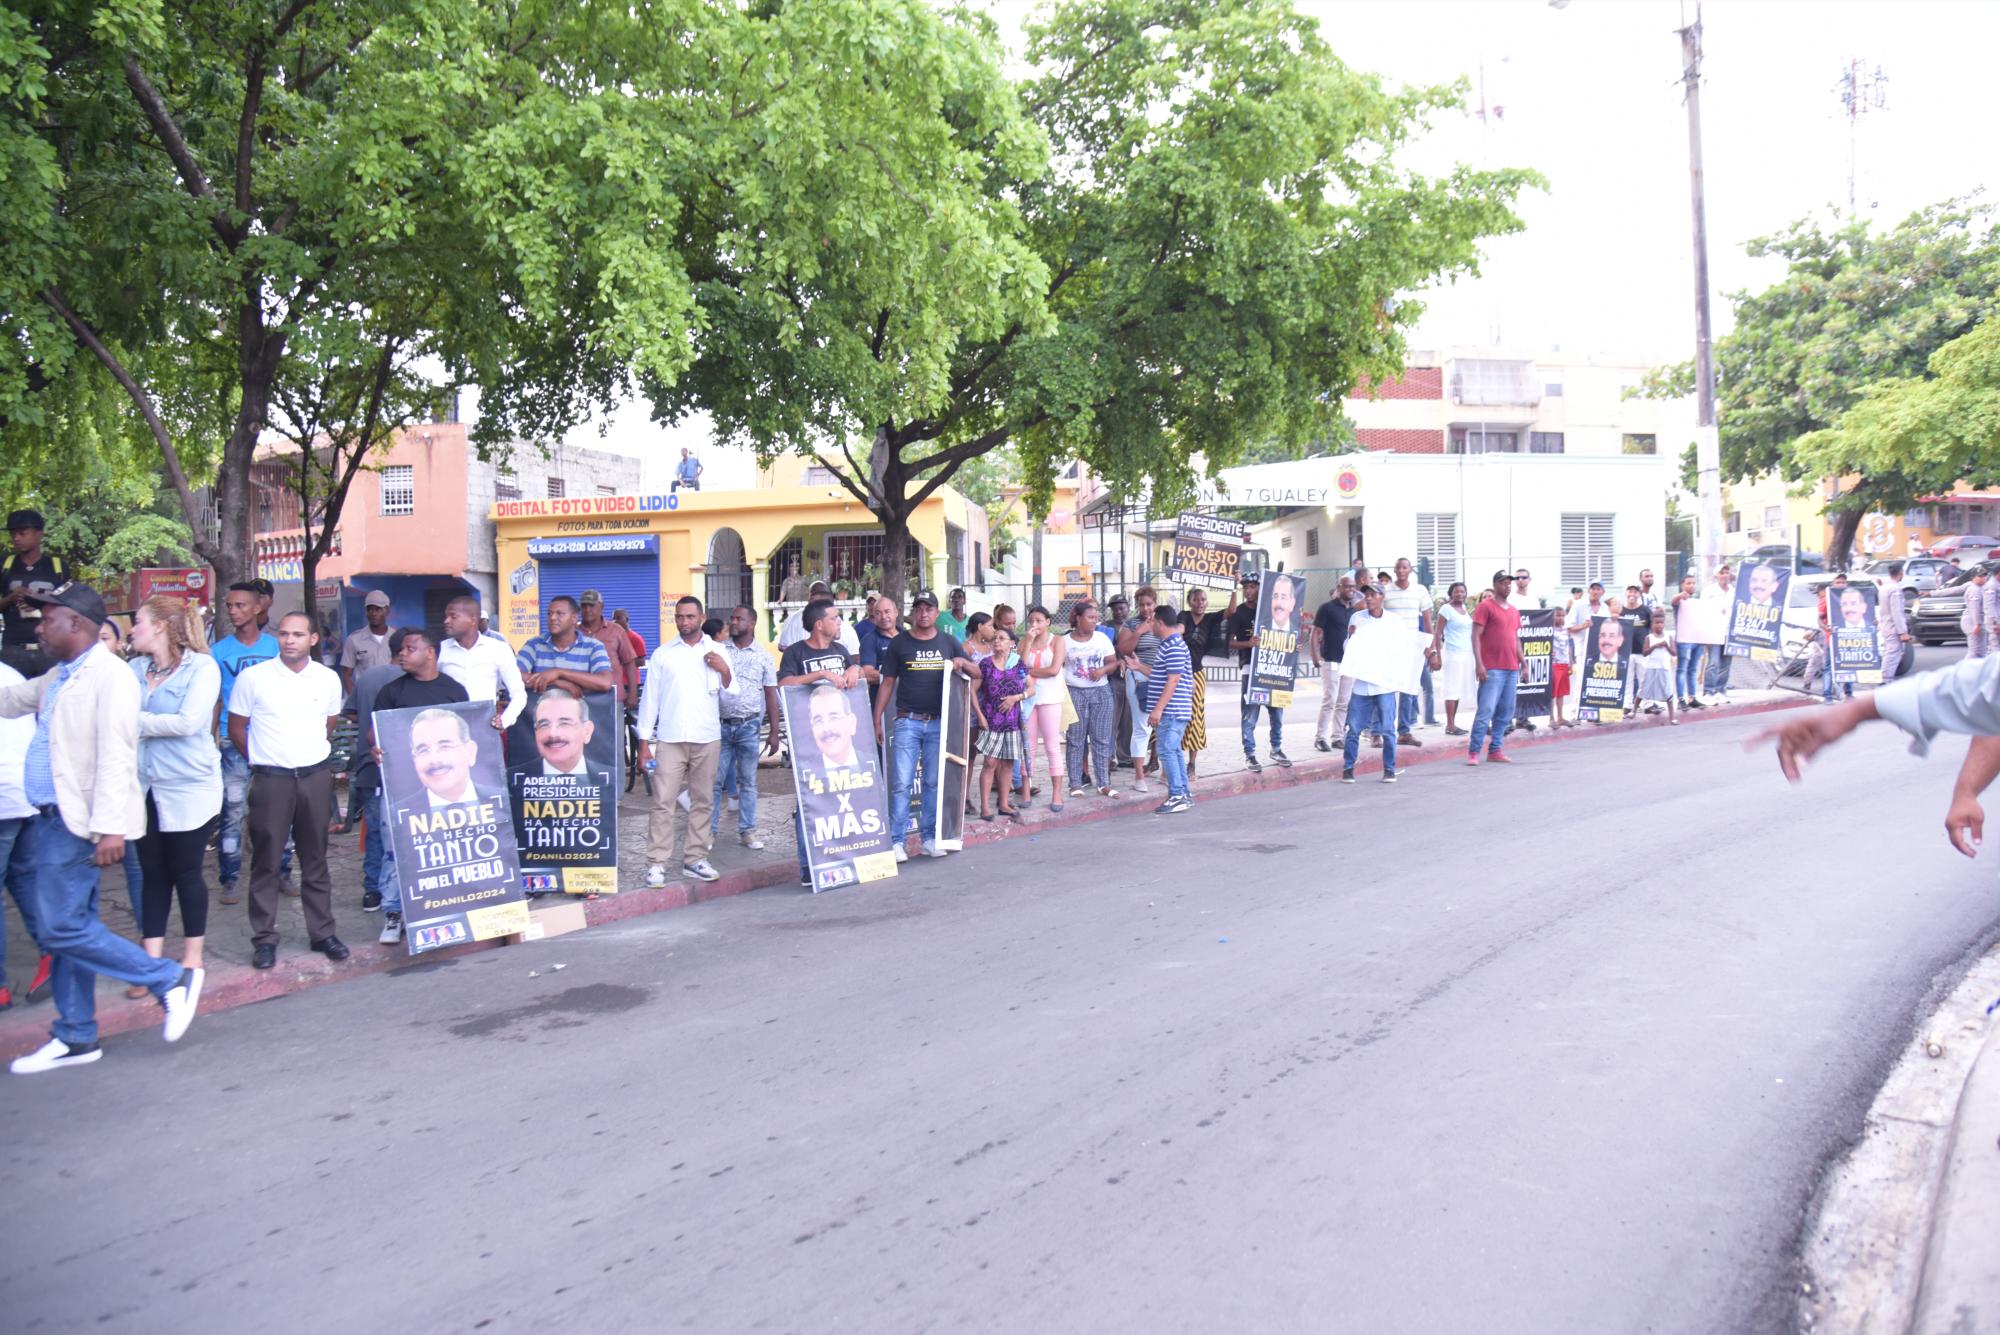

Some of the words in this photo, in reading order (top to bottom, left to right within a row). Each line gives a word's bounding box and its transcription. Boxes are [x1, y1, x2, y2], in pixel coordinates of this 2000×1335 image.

[1245, 489, 1253, 502] 7
[1258, 488, 1328, 502] GUALEY
[497, 501, 548, 517] DIGITAL
[552, 498, 591, 514] FOTO
[594, 496, 636, 512] VIDEO
[639, 494, 679, 511] LIDIO
[557, 521, 586, 531] FOTOS
[587, 520, 604, 529] PARA
[605, 519, 622, 529] TODA
[1180, 515, 1244, 536] PRESIDENTE
[1177, 545, 1238, 565] HONESTO
[258, 562, 301, 581] BANCA
[1181, 558, 1236, 577] MORAL
[1172, 572, 1180, 581] EL
[1181, 572, 1209, 587] PUEBLO
[1737, 602, 1779, 623] DANILO
[1260, 629, 1296, 653] DANILO
[1523, 641, 1551, 656] PUEBLO
[1838, 639, 1872, 648] NADIE
[916, 650, 942, 658] SIGA
[1258, 649, 1268, 663] ES
[1268, 650, 1285, 665] 24/7
[1839, 651, 1873, 662] TANTO
[1592, 661, 1617, 679] SIGA
[523, 776, 577, 786] ADELANTE
[809, 773, 824, 795] 4
[827, 769, 874, 793] Mas
[523, 786, 600, 797] PRESIDENTE
[523, 800, 601, 818] NADIE
[836, 792, 854, 813] X
[408, 803, 496, 835] NADIE
[524, 819, 543, 827] HA
[552, 818, 601, 827] HECHO
[814, 808, 881, 842] MAS
[412, 834, 434, 845] HA
[443, 824, 497, 840] HECHO
[524, 826, 601, 847] TANTO
[414, 834, 499, 868] TANTO
[526, 852, 600, 860] #DANILO2024
[417, 876, 439, 891] POR
[439, 874, 452, 888] EL
[452, 860, 504, 885] PUEBLO
[423, 887, 506, 910] #DANILO2024
